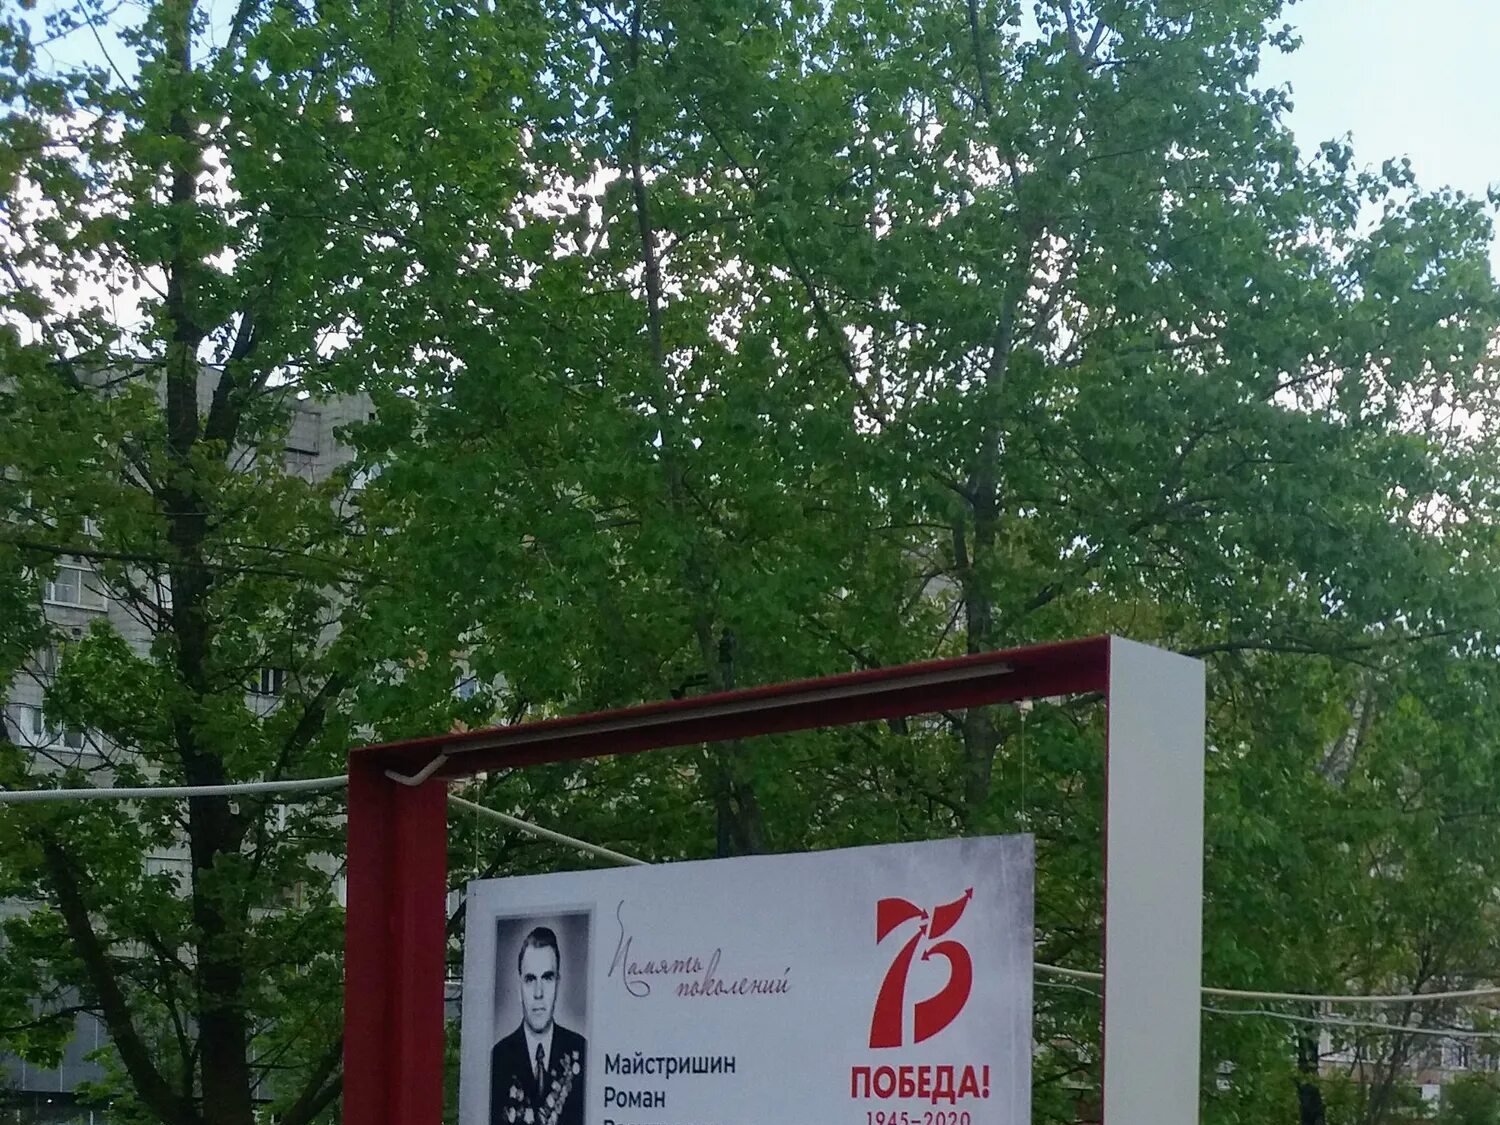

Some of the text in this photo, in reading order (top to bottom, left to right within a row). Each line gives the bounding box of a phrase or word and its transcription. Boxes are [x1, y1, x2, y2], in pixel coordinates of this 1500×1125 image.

[604, 1051, 736, 1078] Майстришин
[604, 1086, 666, 1108] Роман
[851, 1064, 990, 1106] ПОБЕДА!
